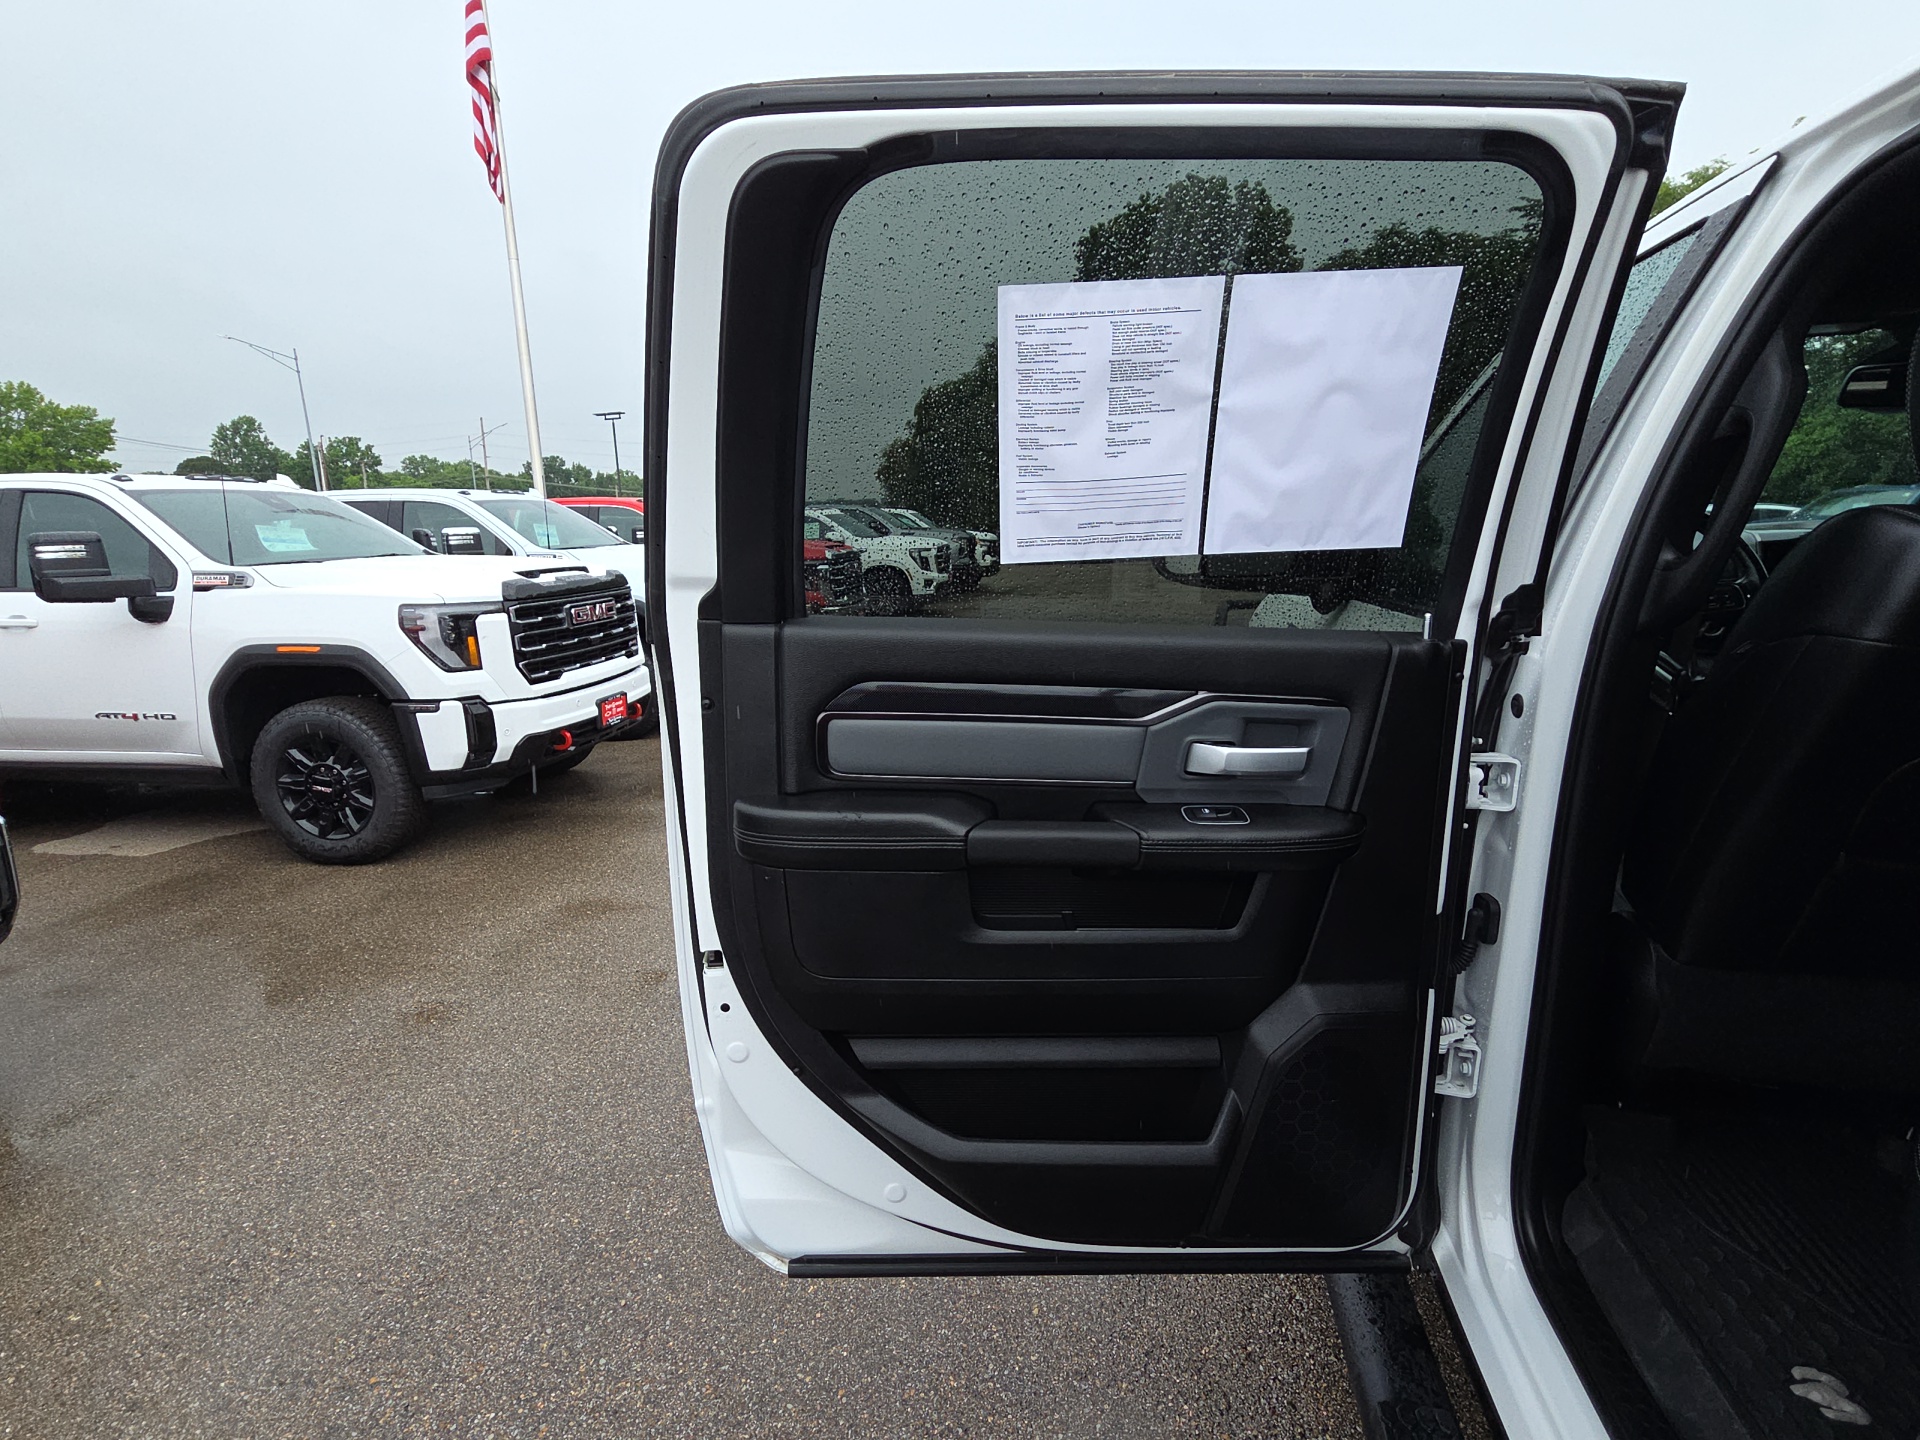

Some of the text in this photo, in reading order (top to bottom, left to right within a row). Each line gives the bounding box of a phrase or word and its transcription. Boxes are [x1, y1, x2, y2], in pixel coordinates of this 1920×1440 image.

[571, 601, 617, 625] GMC
[95, 712, 177, 722] AT4 HD
